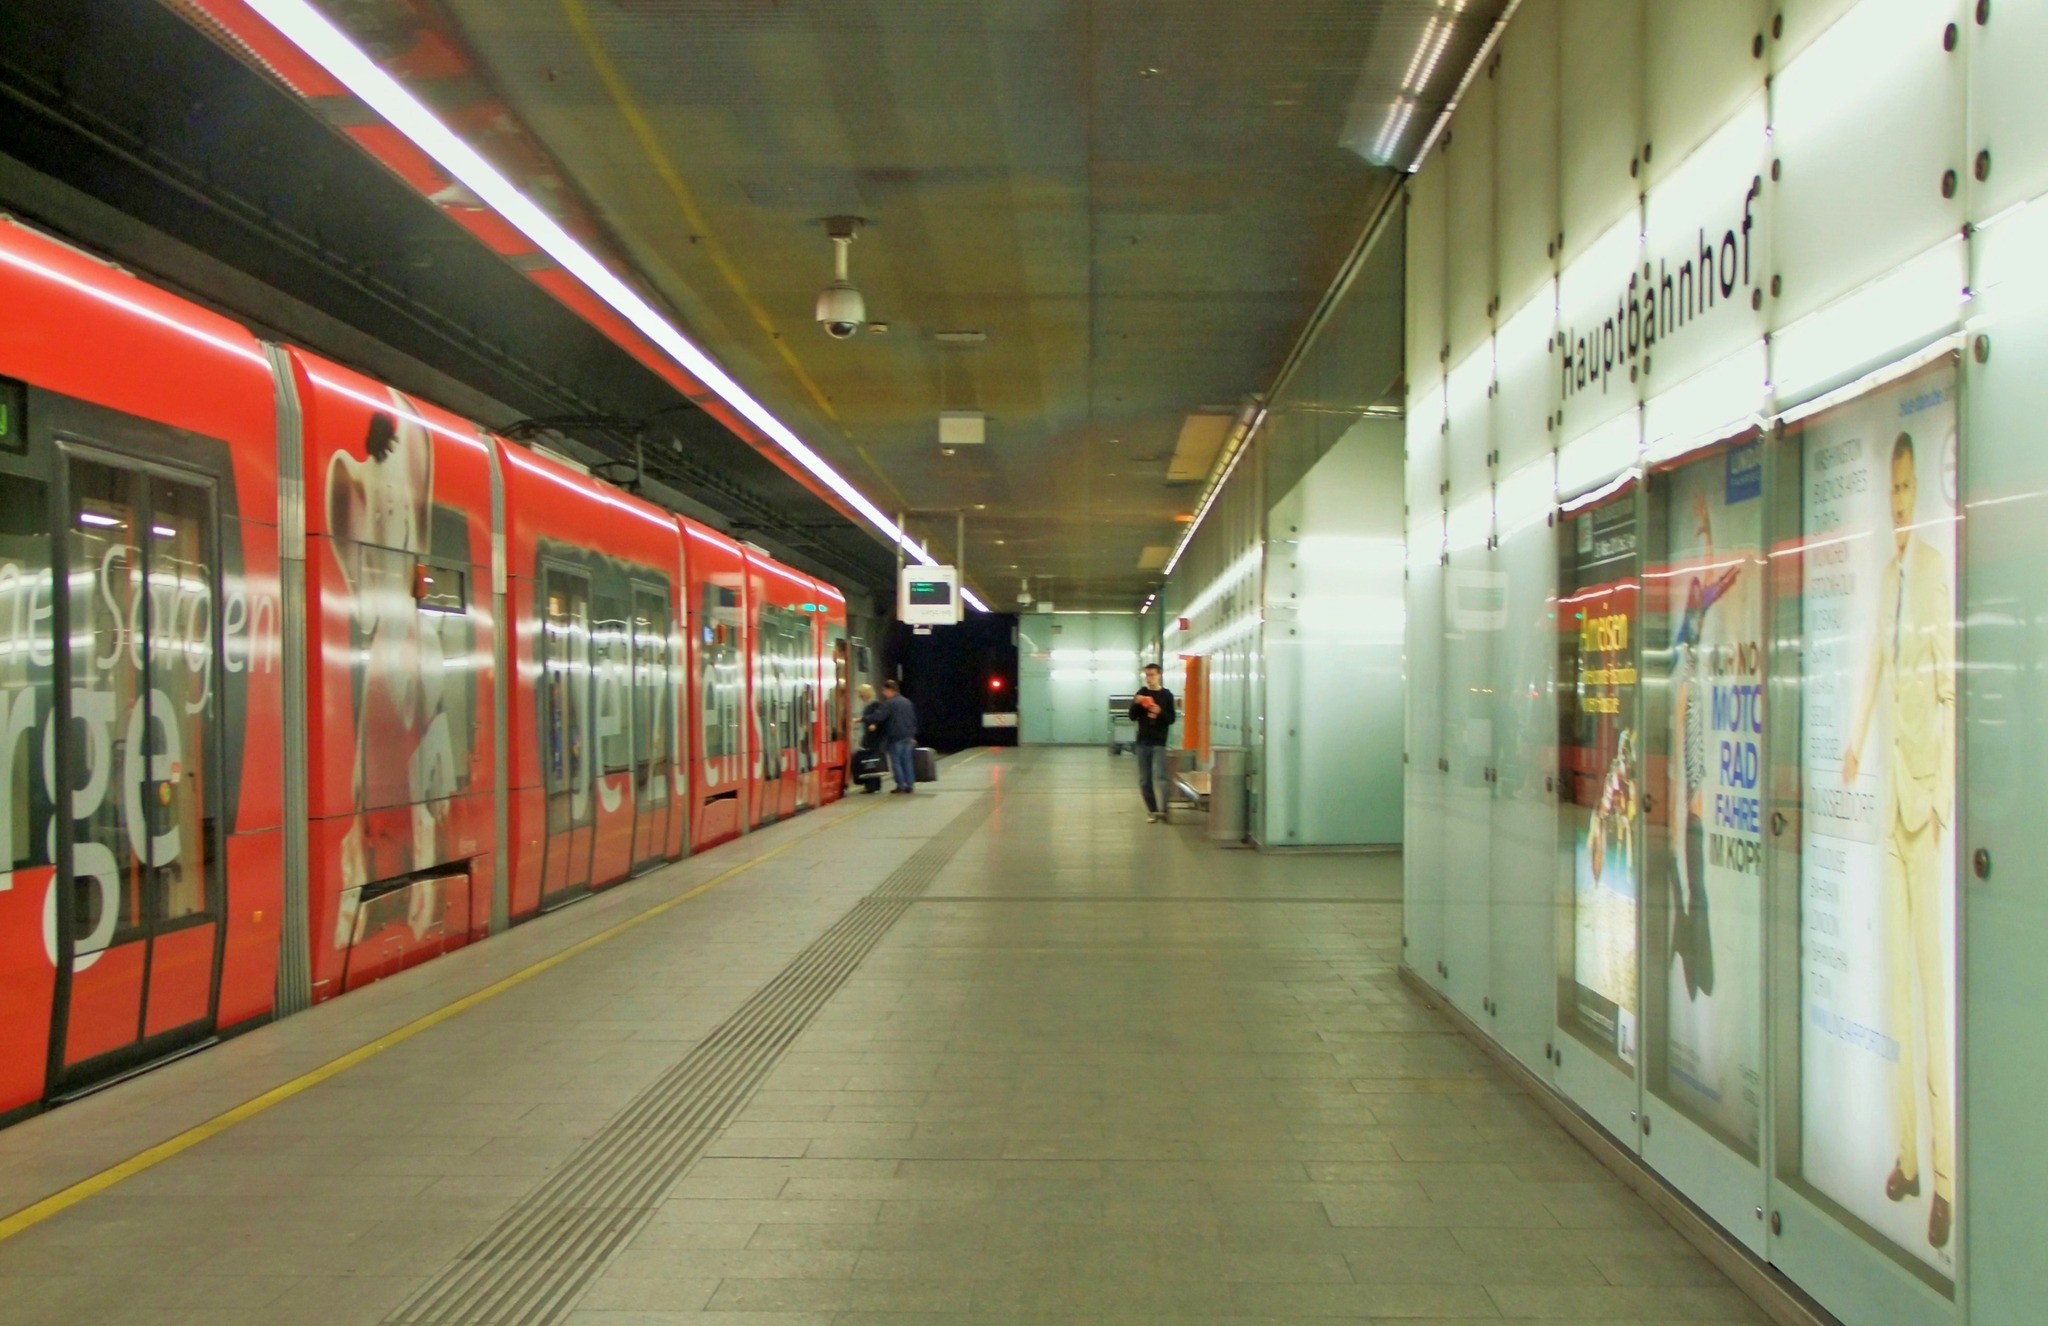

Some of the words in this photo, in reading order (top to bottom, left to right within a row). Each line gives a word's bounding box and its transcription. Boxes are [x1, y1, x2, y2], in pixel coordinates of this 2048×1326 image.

[1561, 188, 1757, 401] Hauptbahnhof
[97, 544, 274, 715] Sorgen
[1720, 740, 1758, 789] RAD
